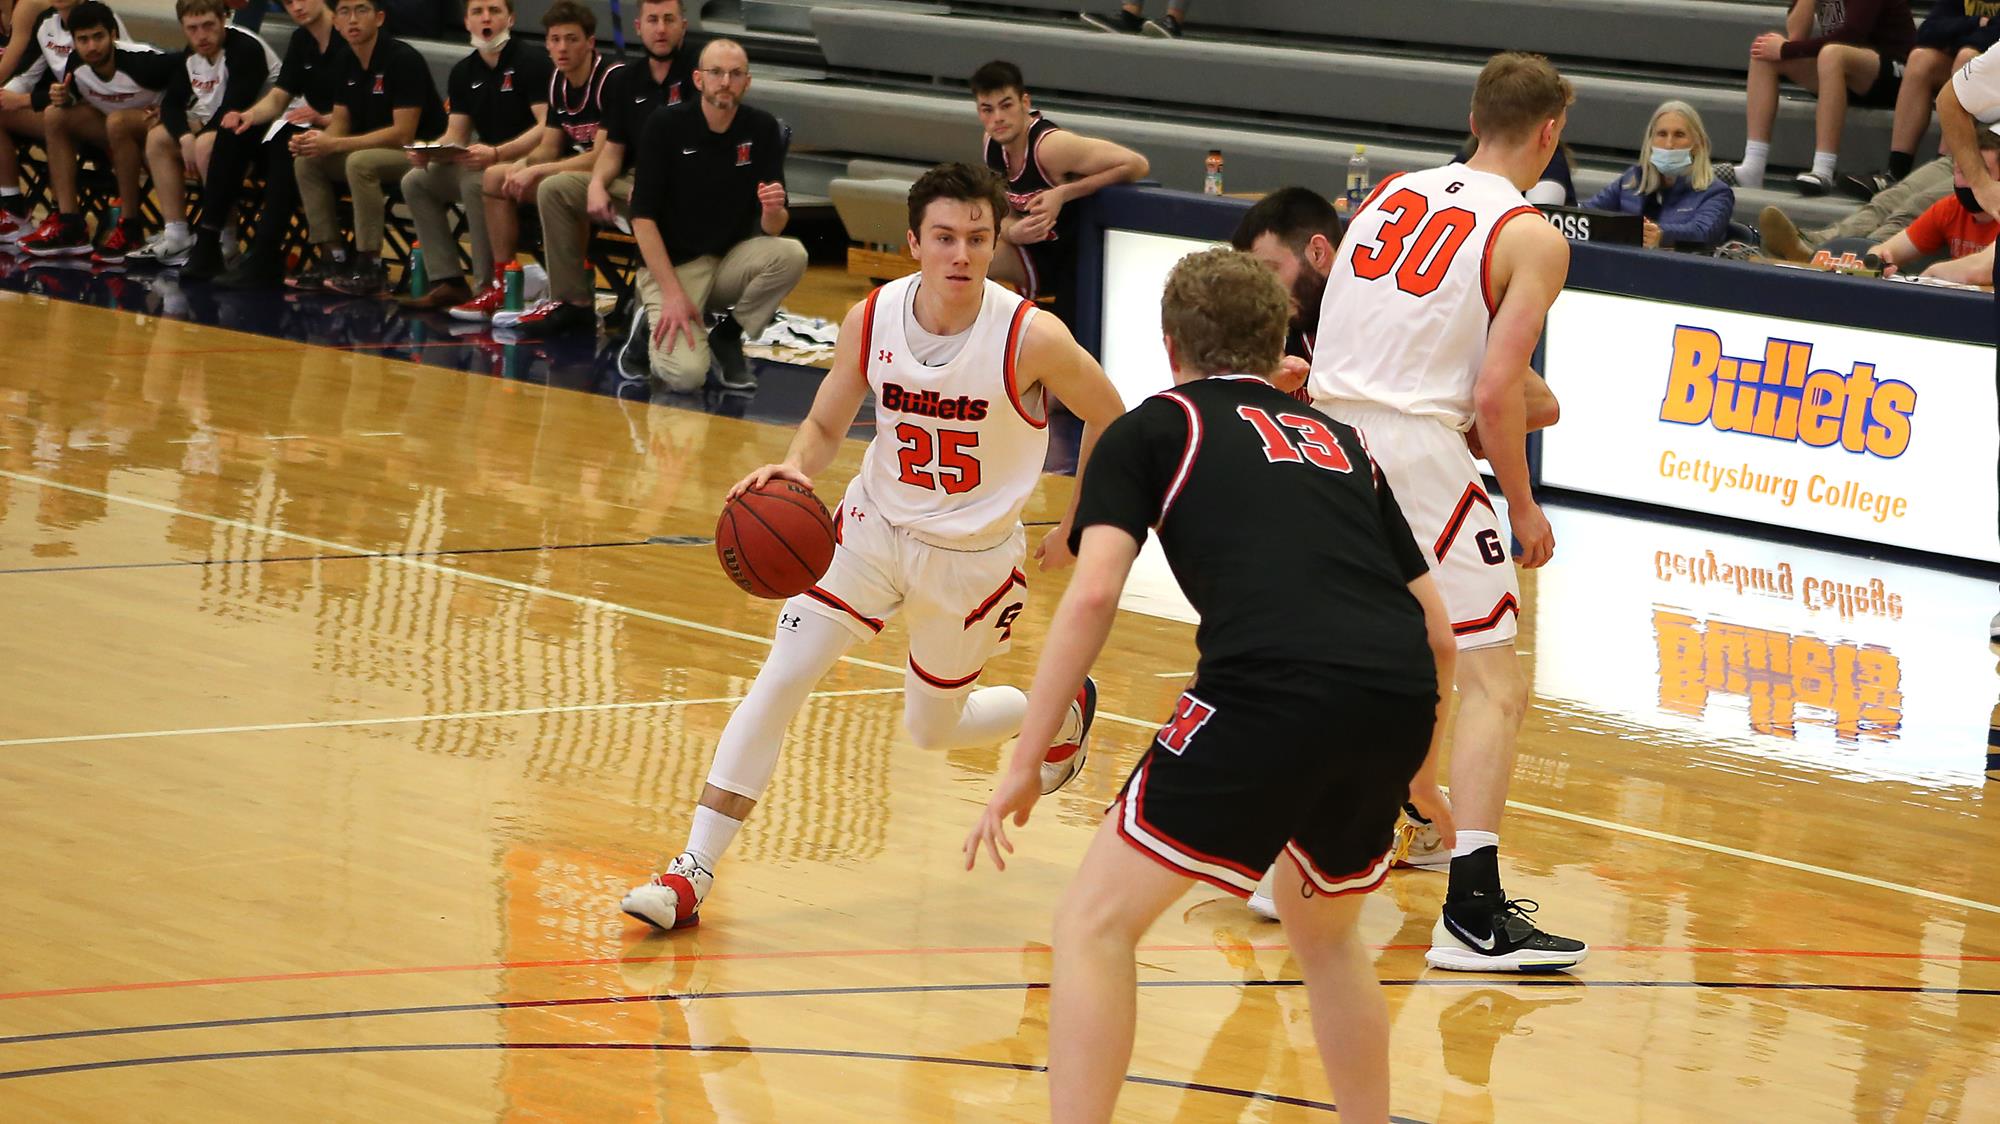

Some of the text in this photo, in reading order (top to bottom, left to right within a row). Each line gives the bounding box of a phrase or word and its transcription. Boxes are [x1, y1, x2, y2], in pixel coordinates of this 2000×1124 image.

[1445, 182, 1464, 194] G
[1351, 188, 1476, 297] 30
[1543, 213, 1590, 241] OSS
[881, 382, 989, 421] Bullets
[1659, 324, 1917, 459] Bullets
[895, 422, 980, 494] 25
[1236, 405, 1352, 473] 13
[1659, 450, 1907, 522] Gettysburg College
[1475, 528, 1505, 565] G
[1157, 691, 1216, 756] H
